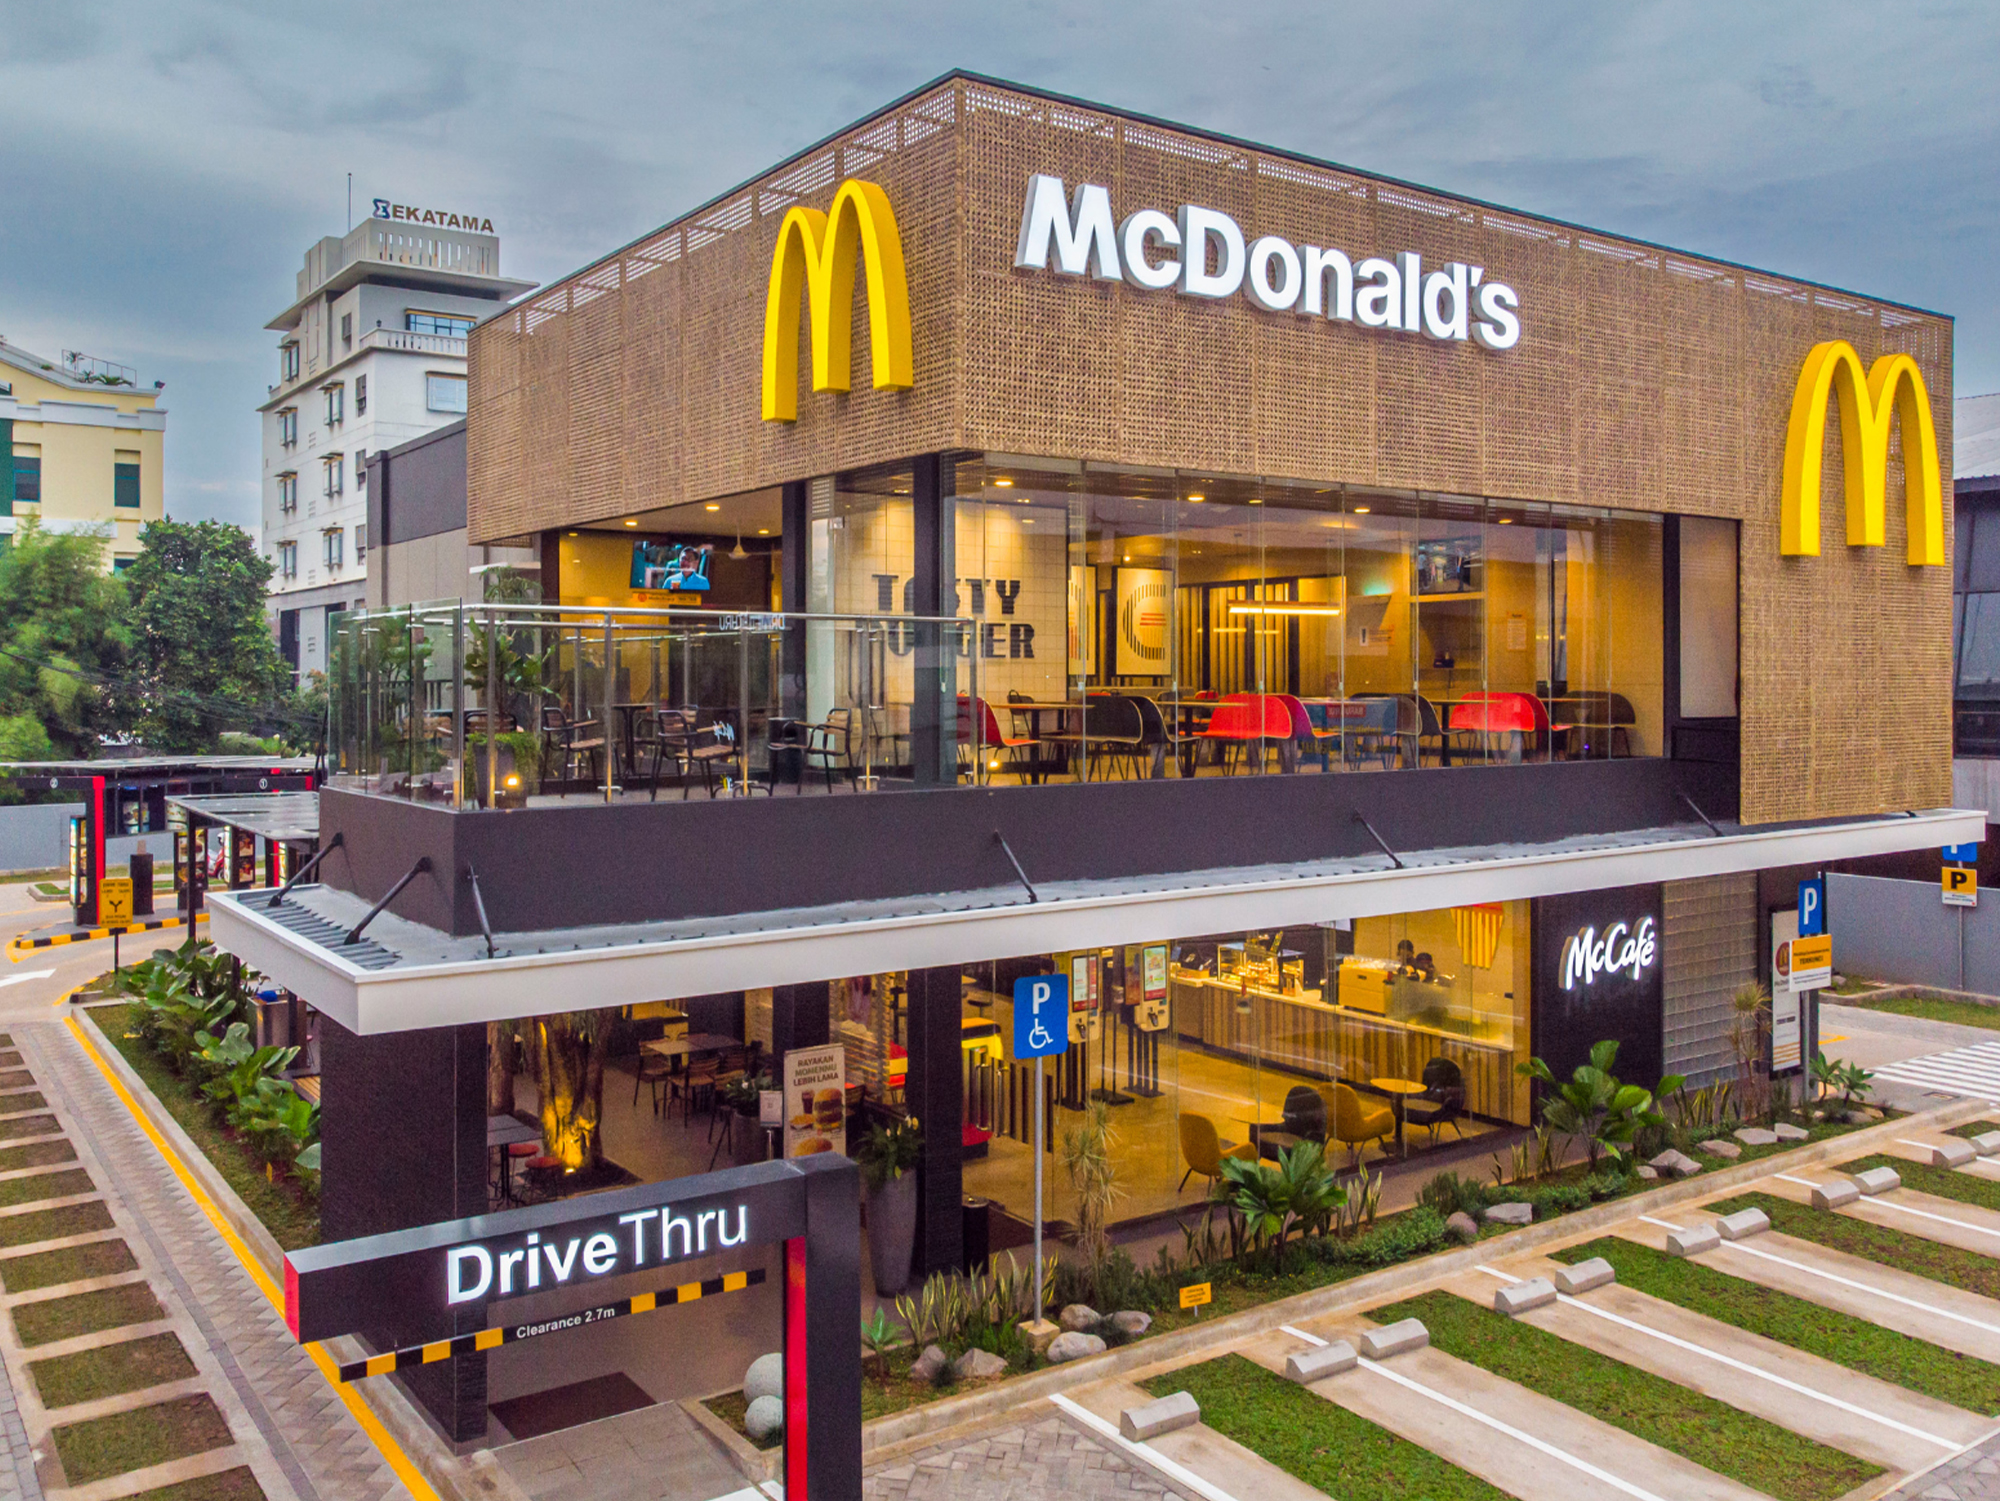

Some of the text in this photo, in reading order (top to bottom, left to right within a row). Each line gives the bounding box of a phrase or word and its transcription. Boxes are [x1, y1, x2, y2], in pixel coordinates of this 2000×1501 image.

[1015, 173, 1521, 350] McDonald's
[1951, 871, 1967, 890] P
[1803, 887, 1817, 925] P
[1564, 916, 1655, 990] McCafé
[1032, 982, 1051, 1015] P
[798, 1055, 834, 1067] RAYAKAN
[793, 1072, 839, 1087] LEBIH LAMA
[516, 1306, 616, 1339] Clearance 2.7m
